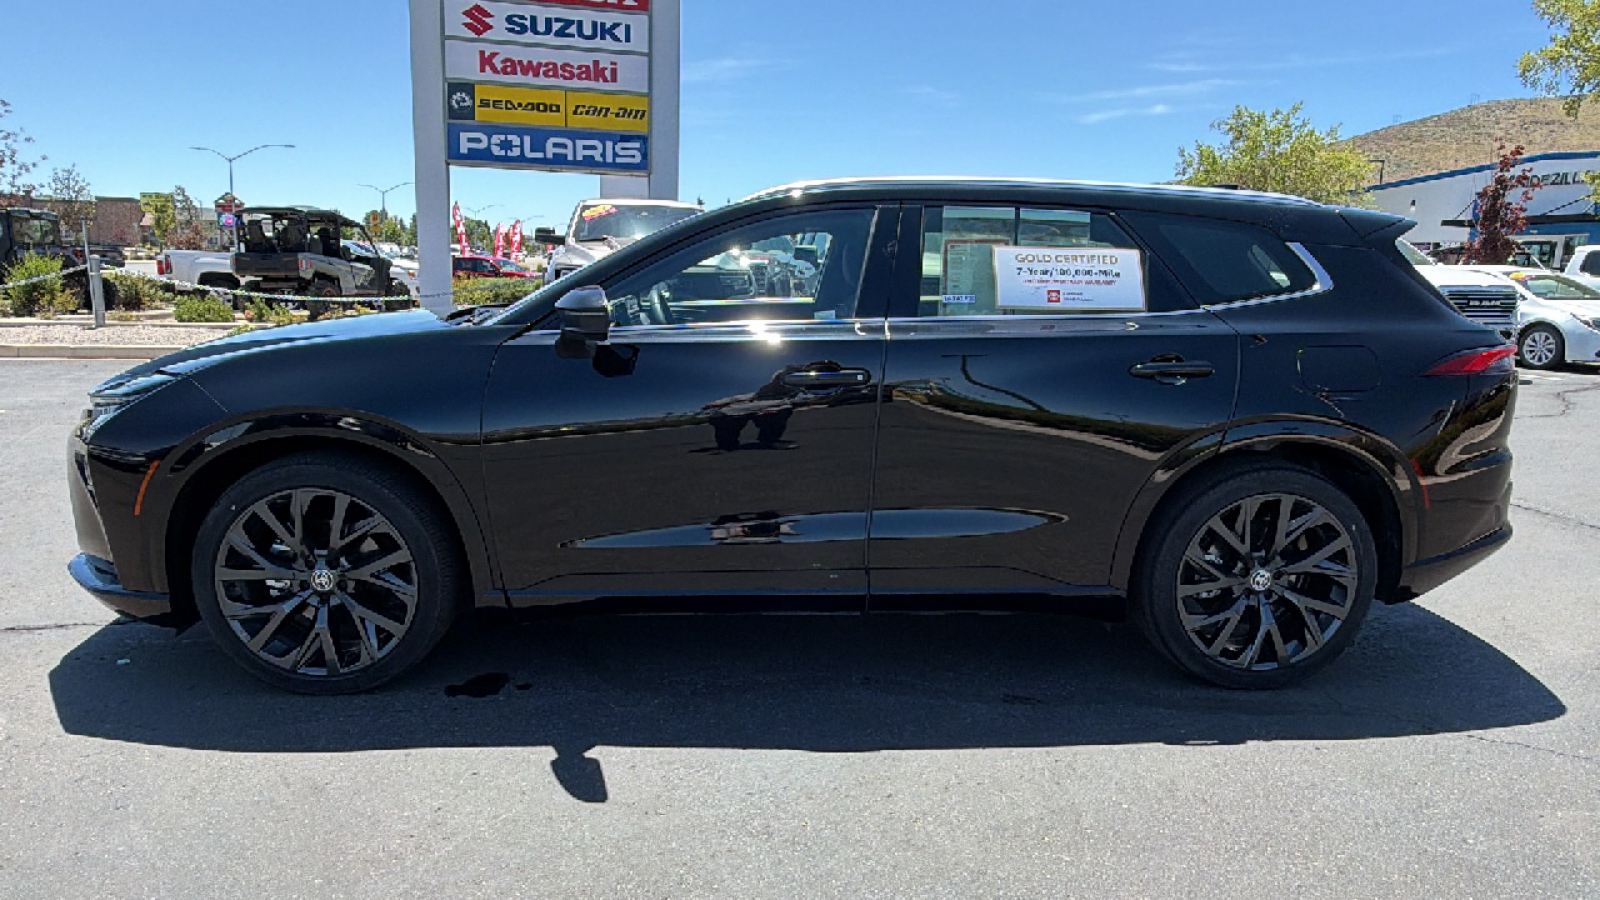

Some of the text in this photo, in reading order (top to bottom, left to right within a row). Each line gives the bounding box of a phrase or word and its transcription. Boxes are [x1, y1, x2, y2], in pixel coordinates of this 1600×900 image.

[504, 14, 631, 43] SUZUKI
[478, 49, 618, 83] Kawasaki
[459, 131, 642, 164] POLARIS
[1015, 253, 1118, 265] GOLD CERTIFIED
